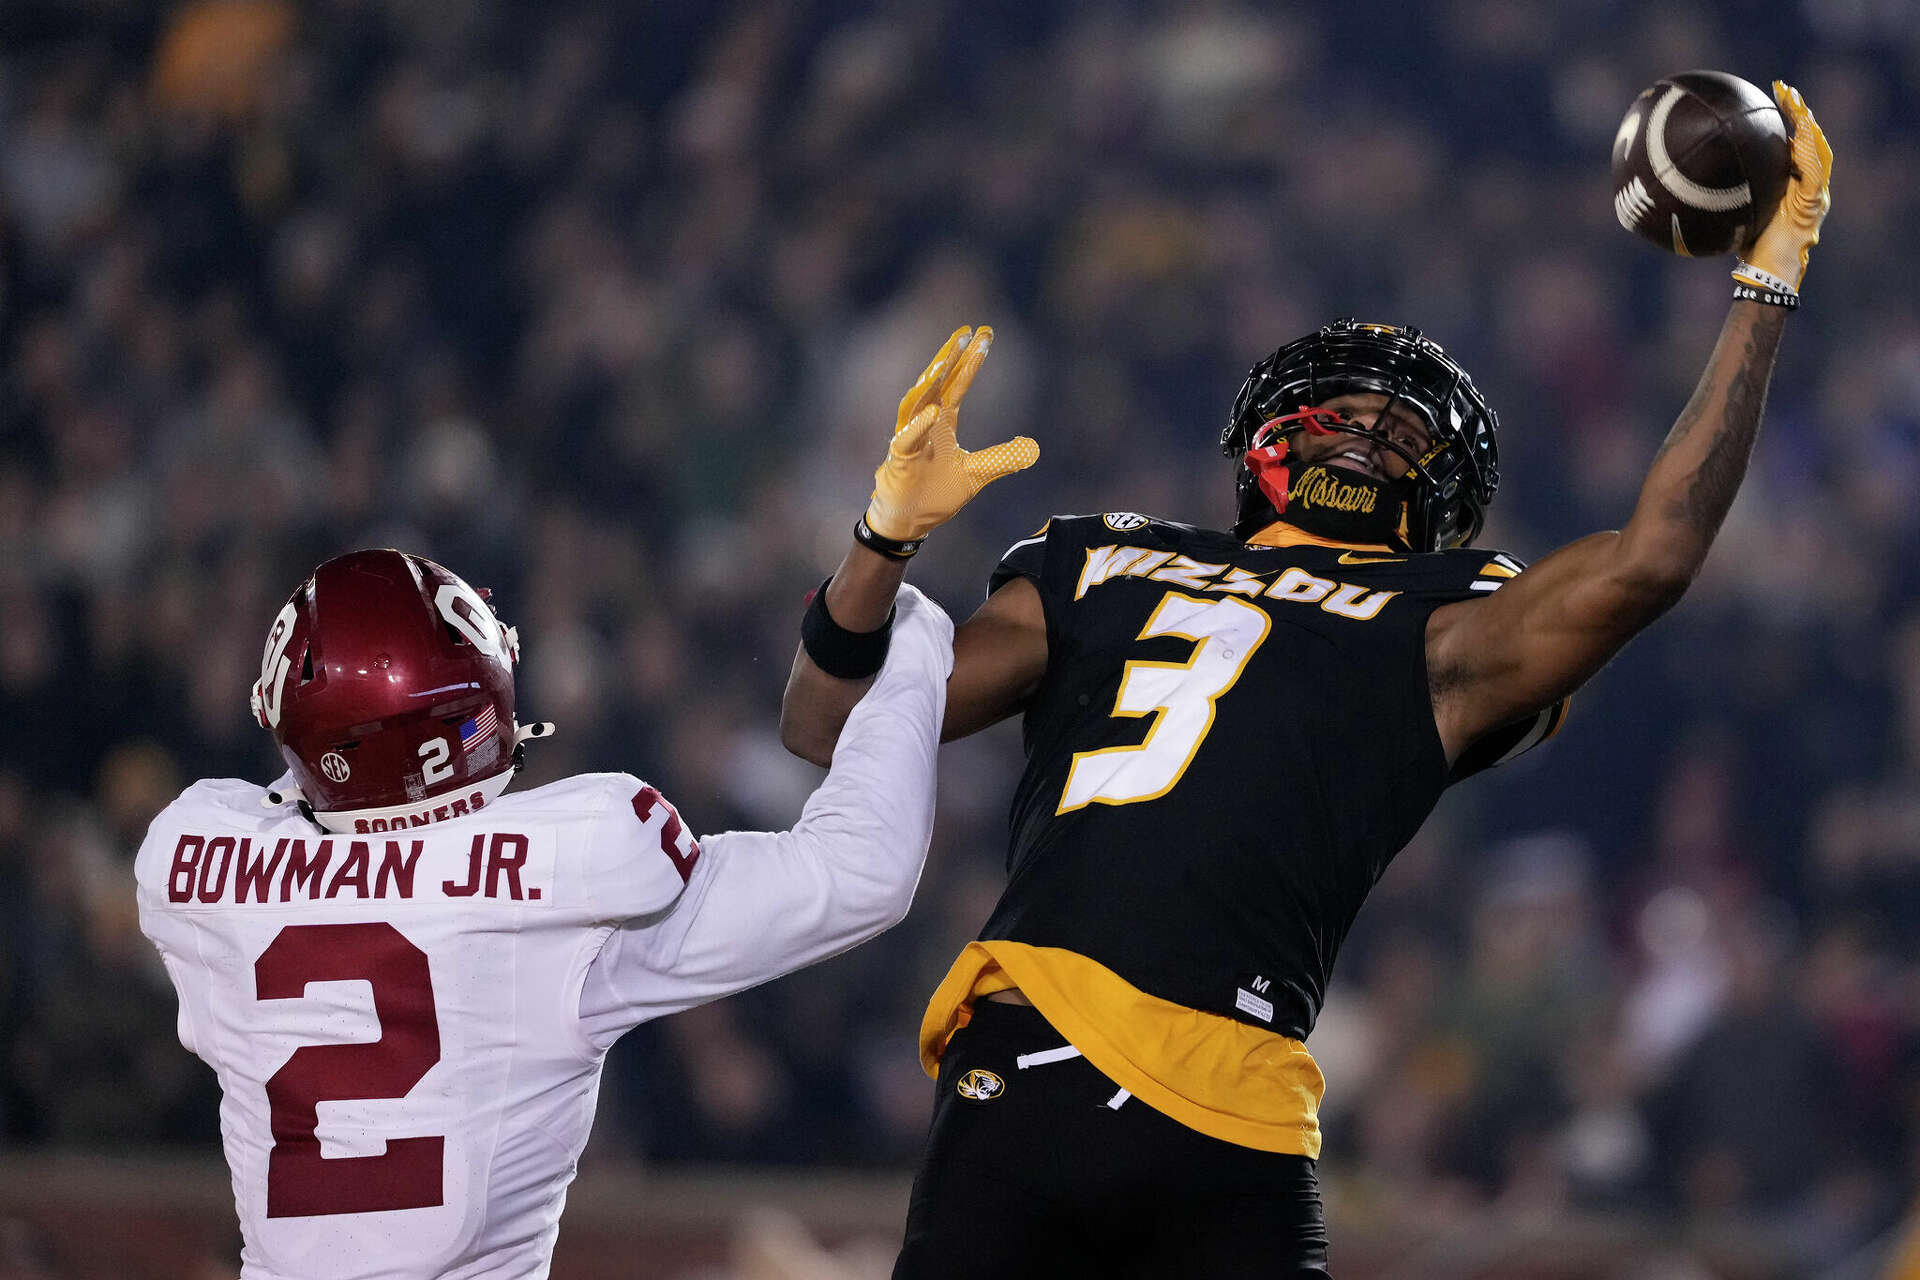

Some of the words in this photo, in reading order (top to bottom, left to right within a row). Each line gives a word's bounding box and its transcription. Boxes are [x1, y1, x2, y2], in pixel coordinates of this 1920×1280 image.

[1406, 442, 1450, 480] MZZOU
[1288, 466, 1378, 513] Missouri
[1056, 591, 1272, 815] 3
[321, 753, 350, 782] SEC
[418, 737, 454, 785] 2
[354, 791, 485, 834] SOONERS
[631, 786, 701, 886] 2
[167, 834, 424, 904] BOWMAN
[441, 833, 542, 901] JR.
[1251, 975, 1271, 994] M
[254, 921, 442, 1219] 2
